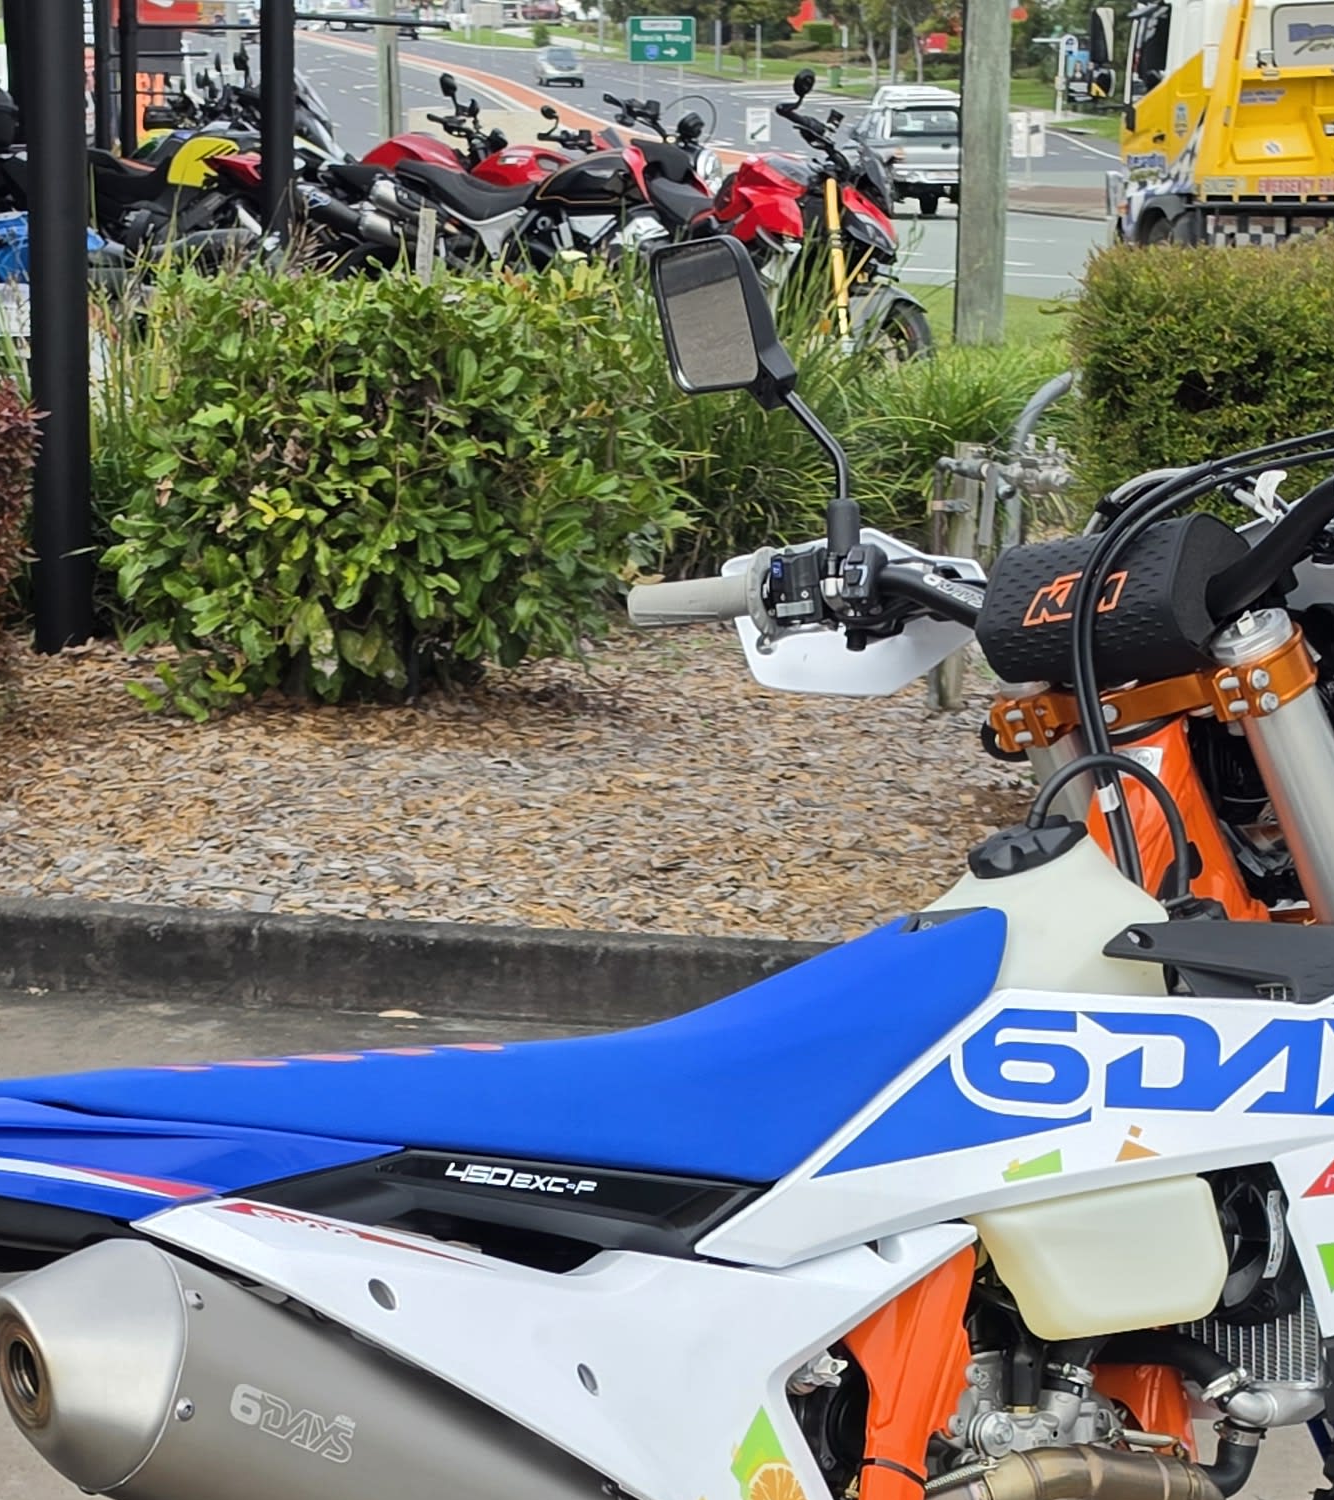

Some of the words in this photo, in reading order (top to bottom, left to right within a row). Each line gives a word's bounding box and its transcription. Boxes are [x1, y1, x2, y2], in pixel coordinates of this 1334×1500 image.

[444, 1162, 514, 1187] 450
[510, 1172, 598, 1195] EXC-F
[230, 1383, 354, 1463] 6DAYS
